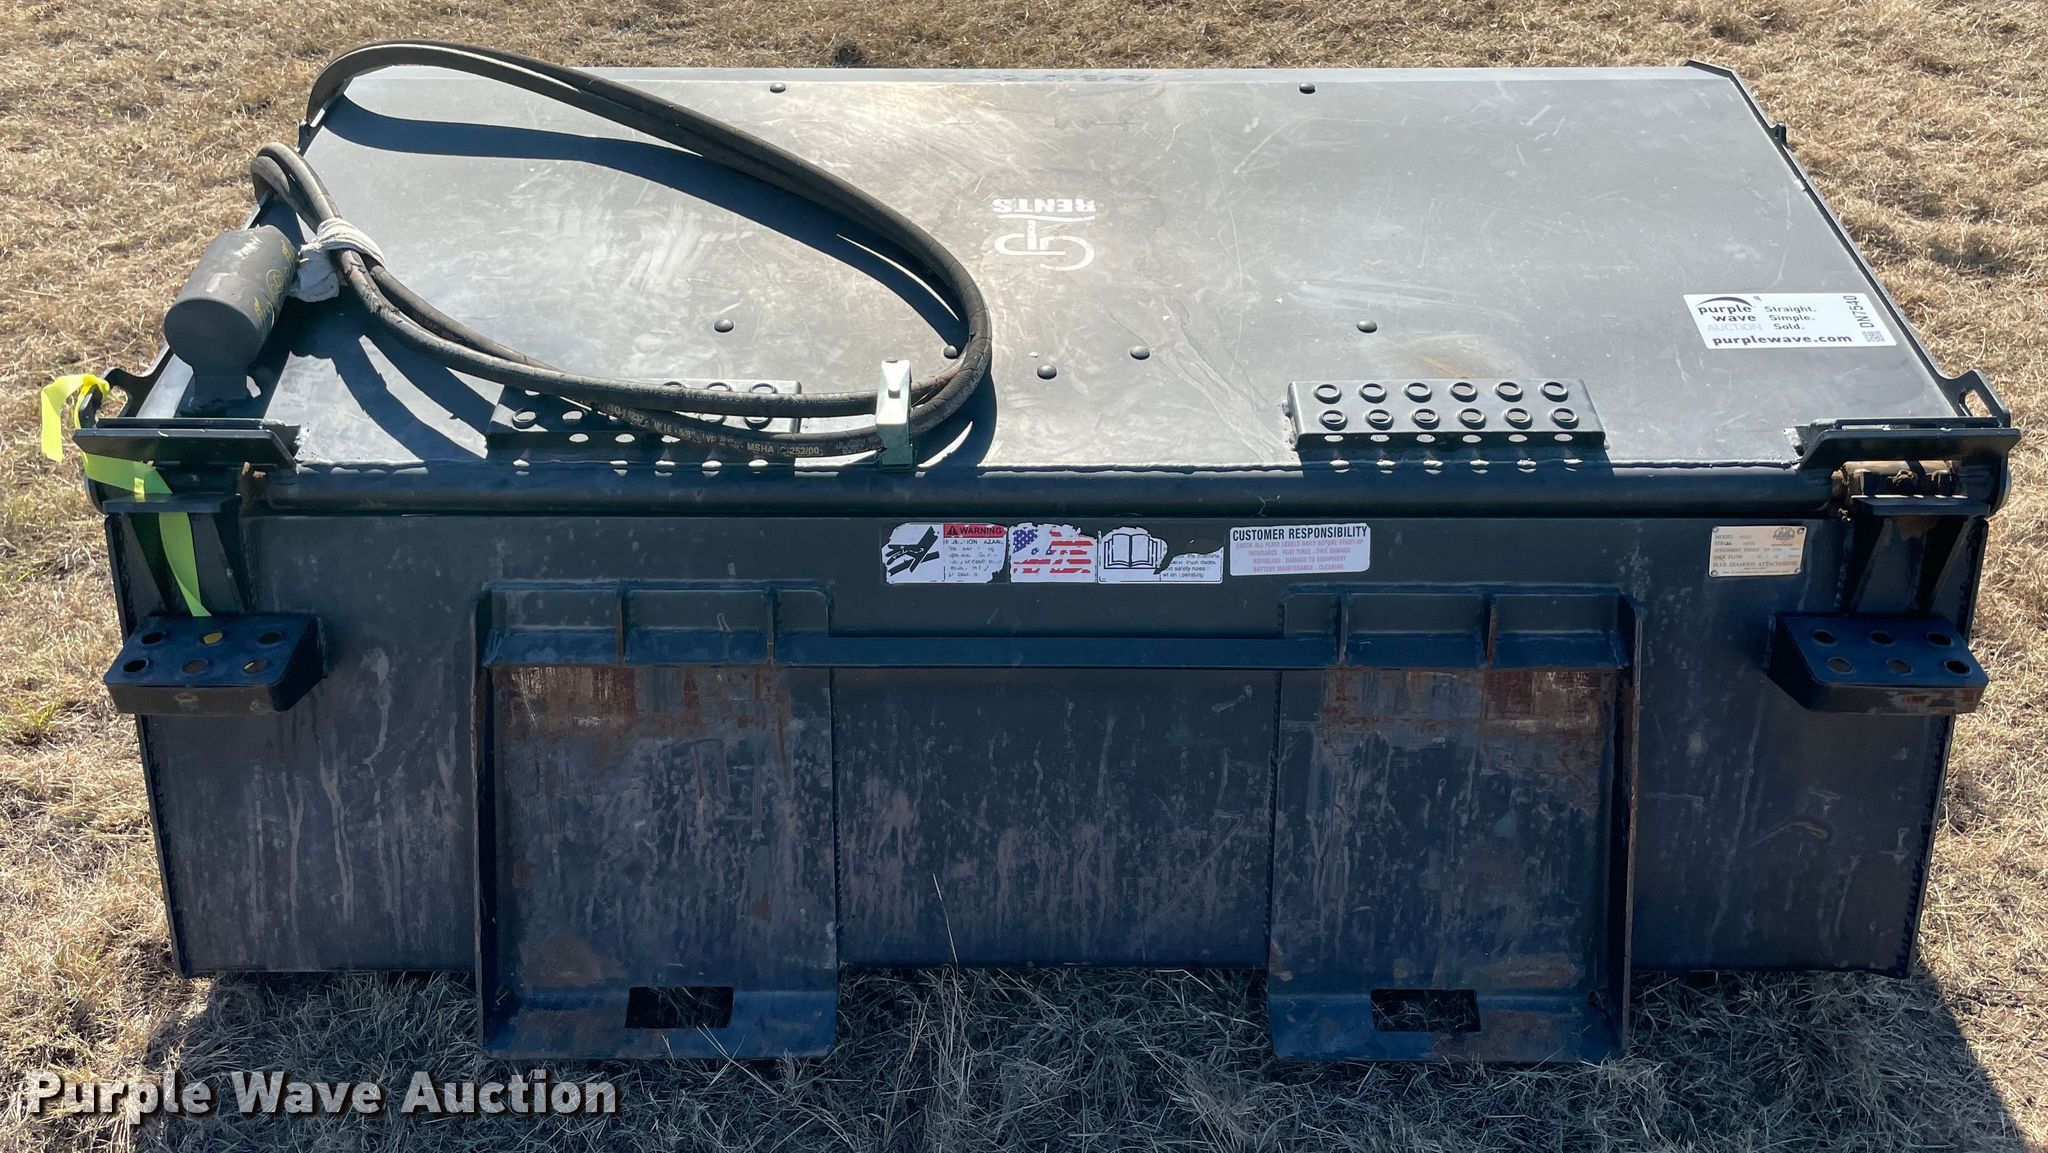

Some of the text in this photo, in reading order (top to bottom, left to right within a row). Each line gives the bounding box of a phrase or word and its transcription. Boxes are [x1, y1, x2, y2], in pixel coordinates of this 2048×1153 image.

[992, 198, 1097, 213] RENTS
[1698, 304, 1752, 315] purple
[1764, 305, 1817, 314] Straight.
[1842, 295, 1874, 328] DN7540
[1768, 314, 1815, 322] Simple.
[1707, 323, 1763, 332] AUCTION
[1712, 335, 1853, 346] purplewave.com
[747, 443, 775, 454] MSHA
[960, 526, 1002, 535] WARNING
[1233, 526, 1368, 541] CUSTOMER RESPONSIBILITY
